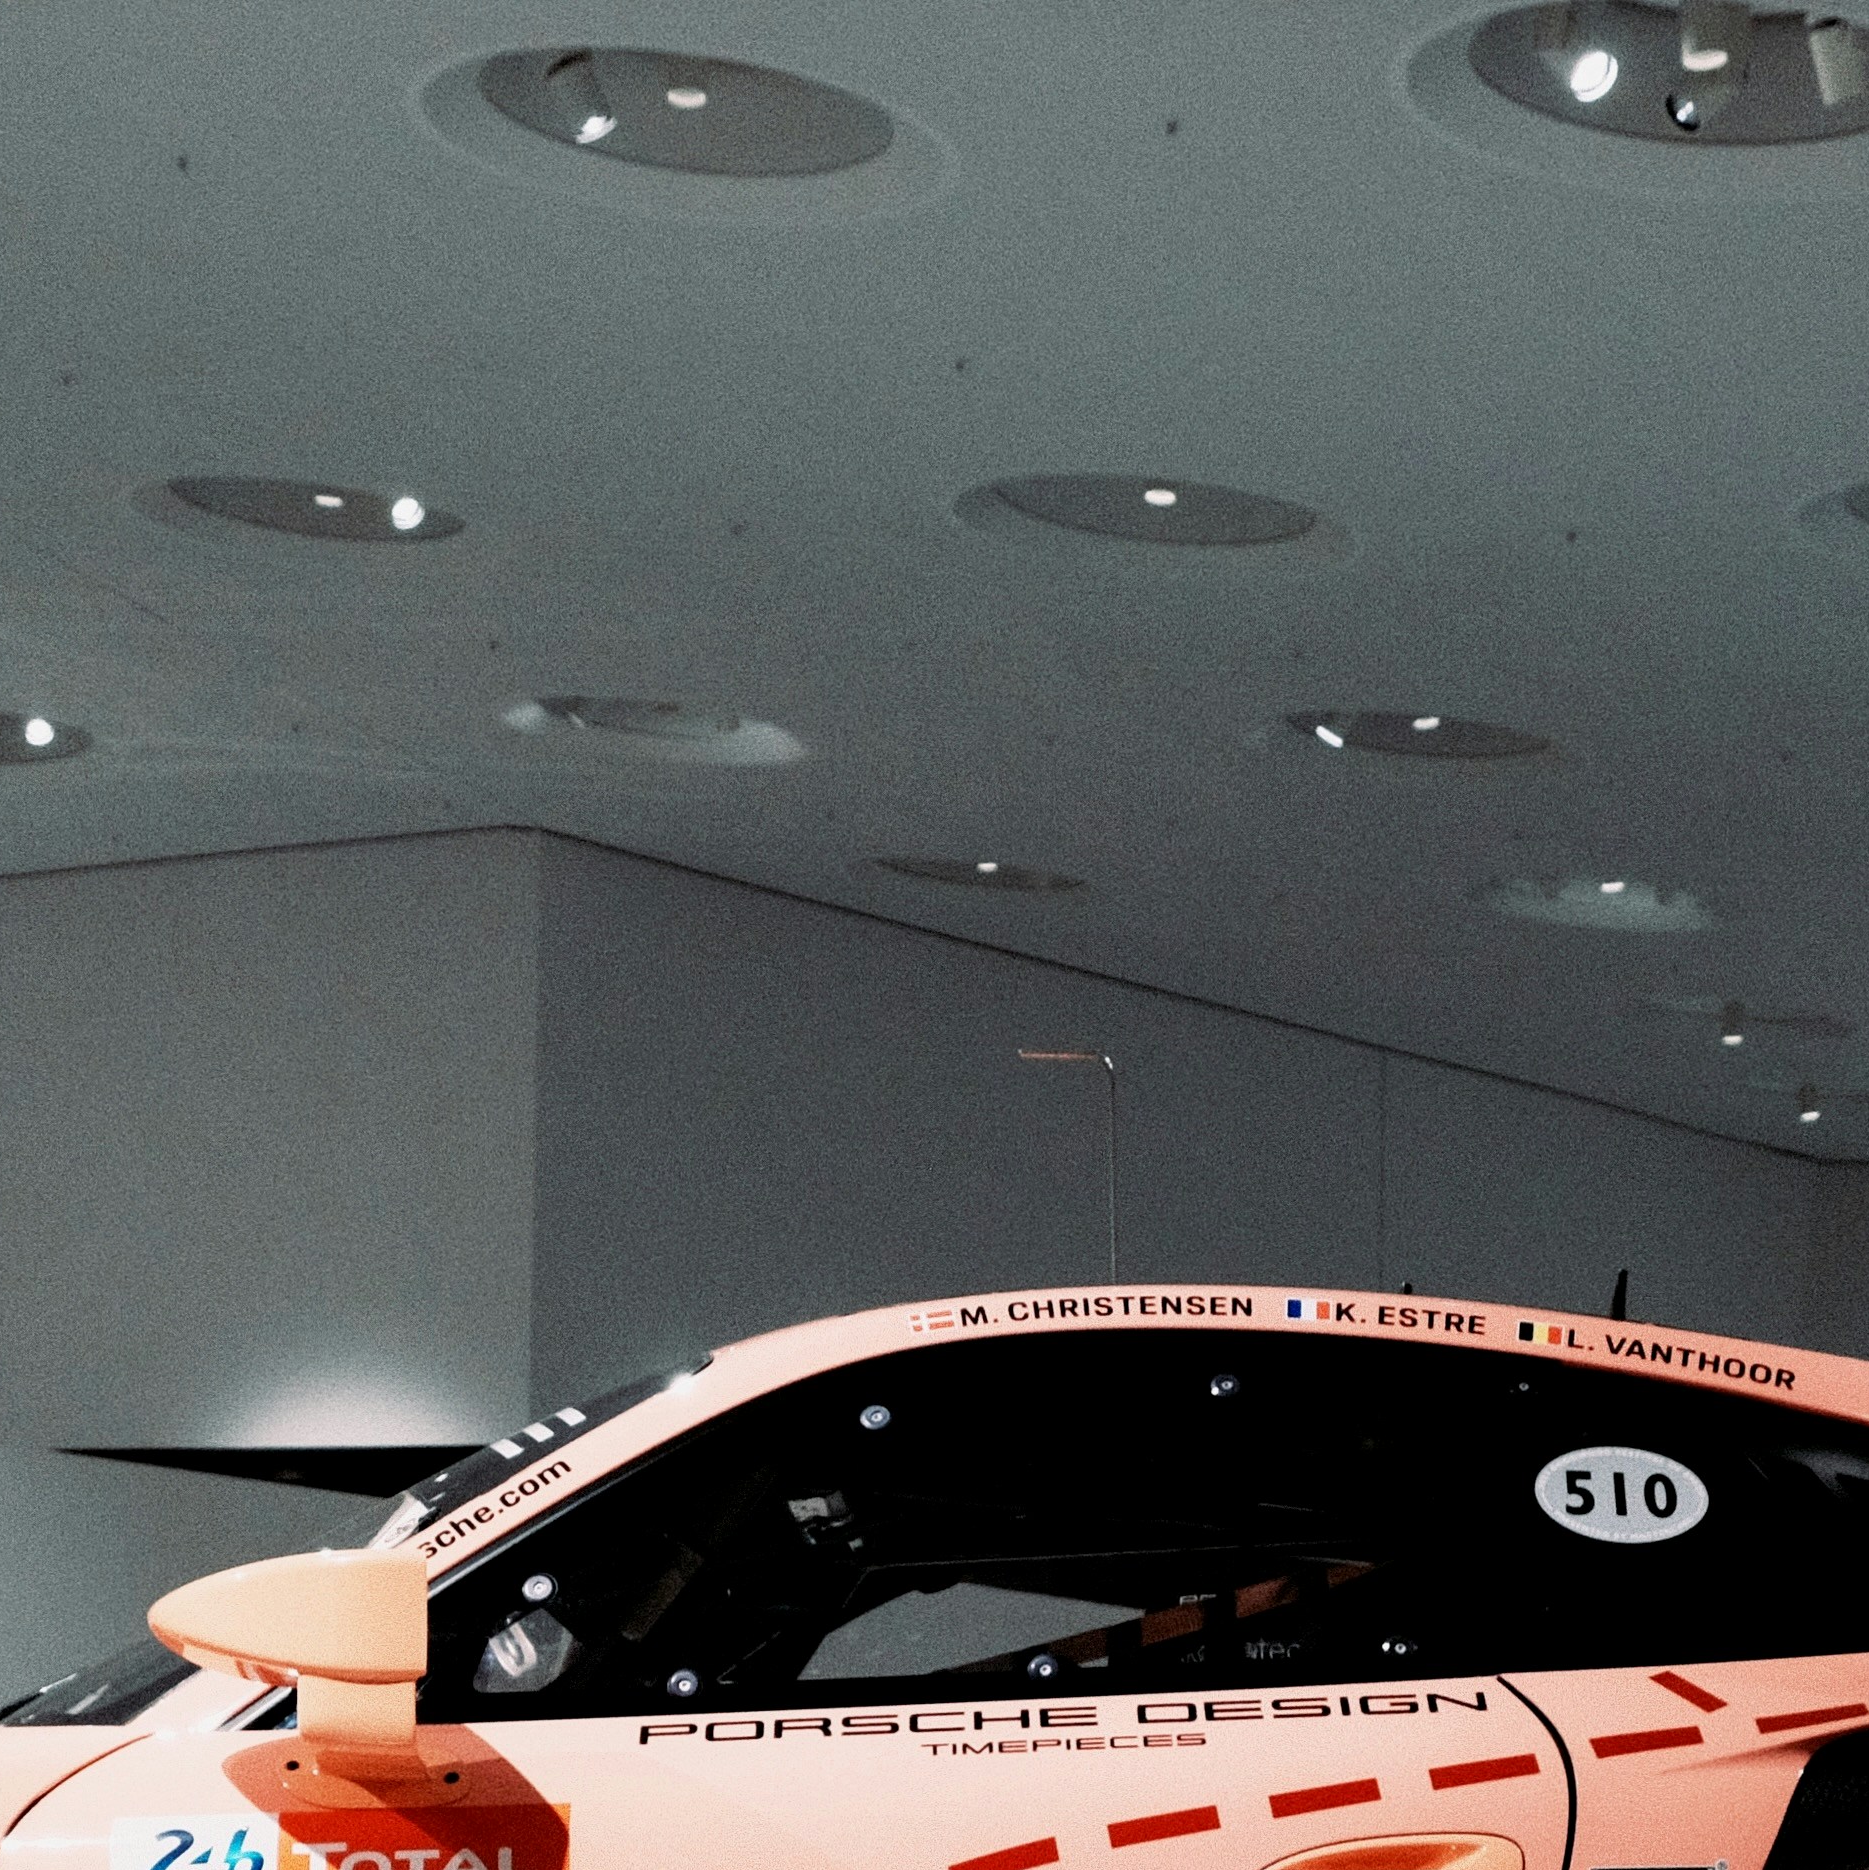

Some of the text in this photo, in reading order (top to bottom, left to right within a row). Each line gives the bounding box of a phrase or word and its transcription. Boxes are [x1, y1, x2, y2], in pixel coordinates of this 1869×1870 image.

[961, 1295, 1253, 1327] M. CHRISTENSEN
[1335, 1302, 1486, 1335] K. ESTRE
[1567, 1329, 1796, 1390] L. VANTHOOR
[1565, 1470, 1678, 1519] 510
[638, 1691, 1489, 1745] PORSCHE DESIGN
[920, 1733, 1207, 1756] TIMEPIECES
